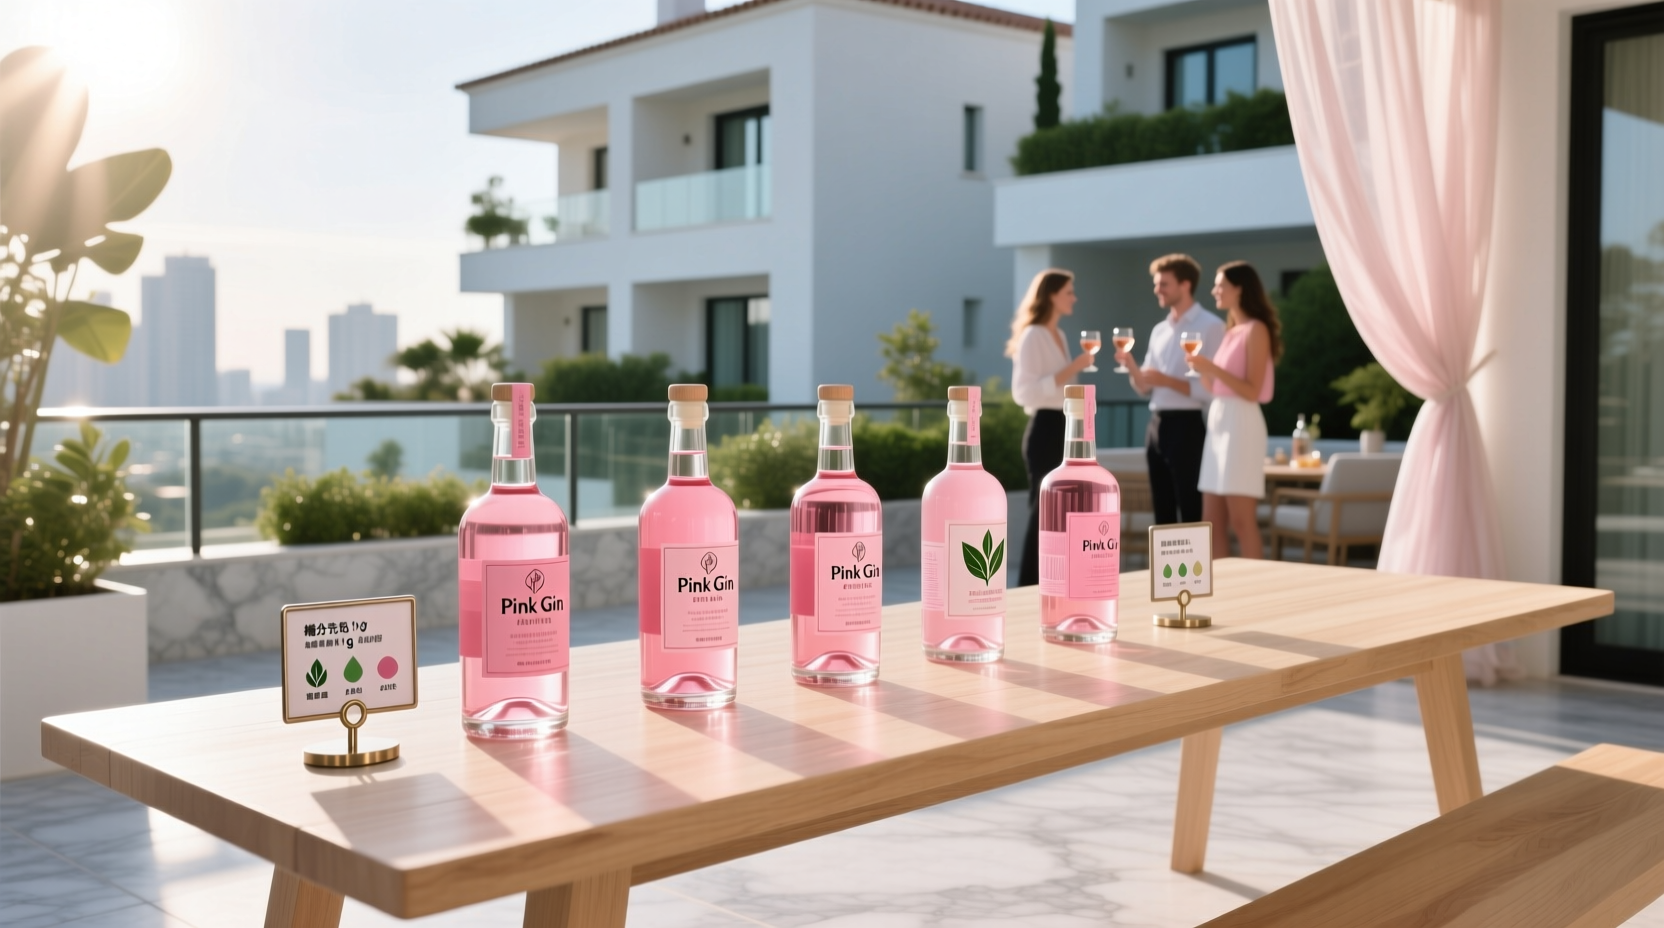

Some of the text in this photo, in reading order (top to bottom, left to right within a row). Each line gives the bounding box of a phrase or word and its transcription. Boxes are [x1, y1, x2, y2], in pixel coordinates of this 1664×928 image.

[831, 564, 880, 580] Pink Gin
[677, 575, 734, 593] Pink Gin
[501, 595, 564, 614] Pink Gin
